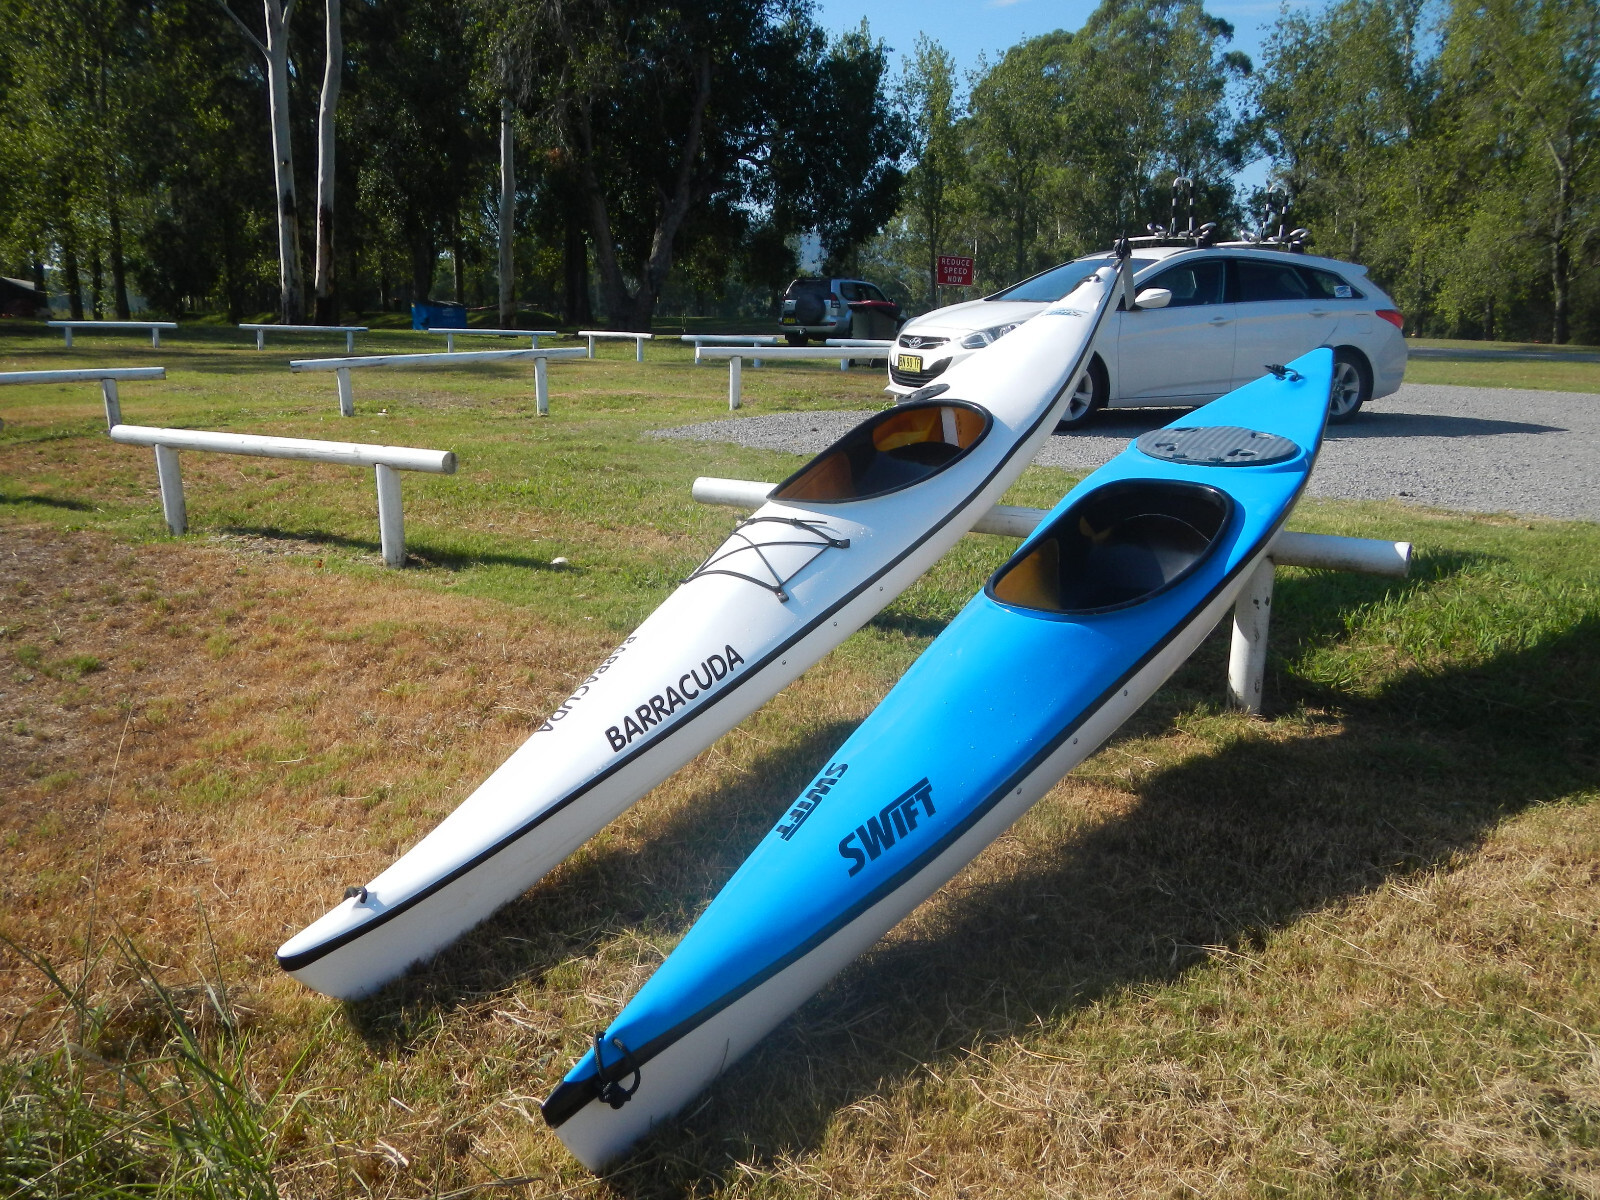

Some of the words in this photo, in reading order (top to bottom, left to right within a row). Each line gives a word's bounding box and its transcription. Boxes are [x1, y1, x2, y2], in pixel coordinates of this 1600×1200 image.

[941, 258, 970, 267] REDUCE
[943, 267, 968, 275] SPEED
[947, 275, 963, 283] NOW
[605, 644, 745, 752] BARRACUDA
[775, 762, 849, 842] SWIFT
[838, 776, 937, 878] SWIFT
